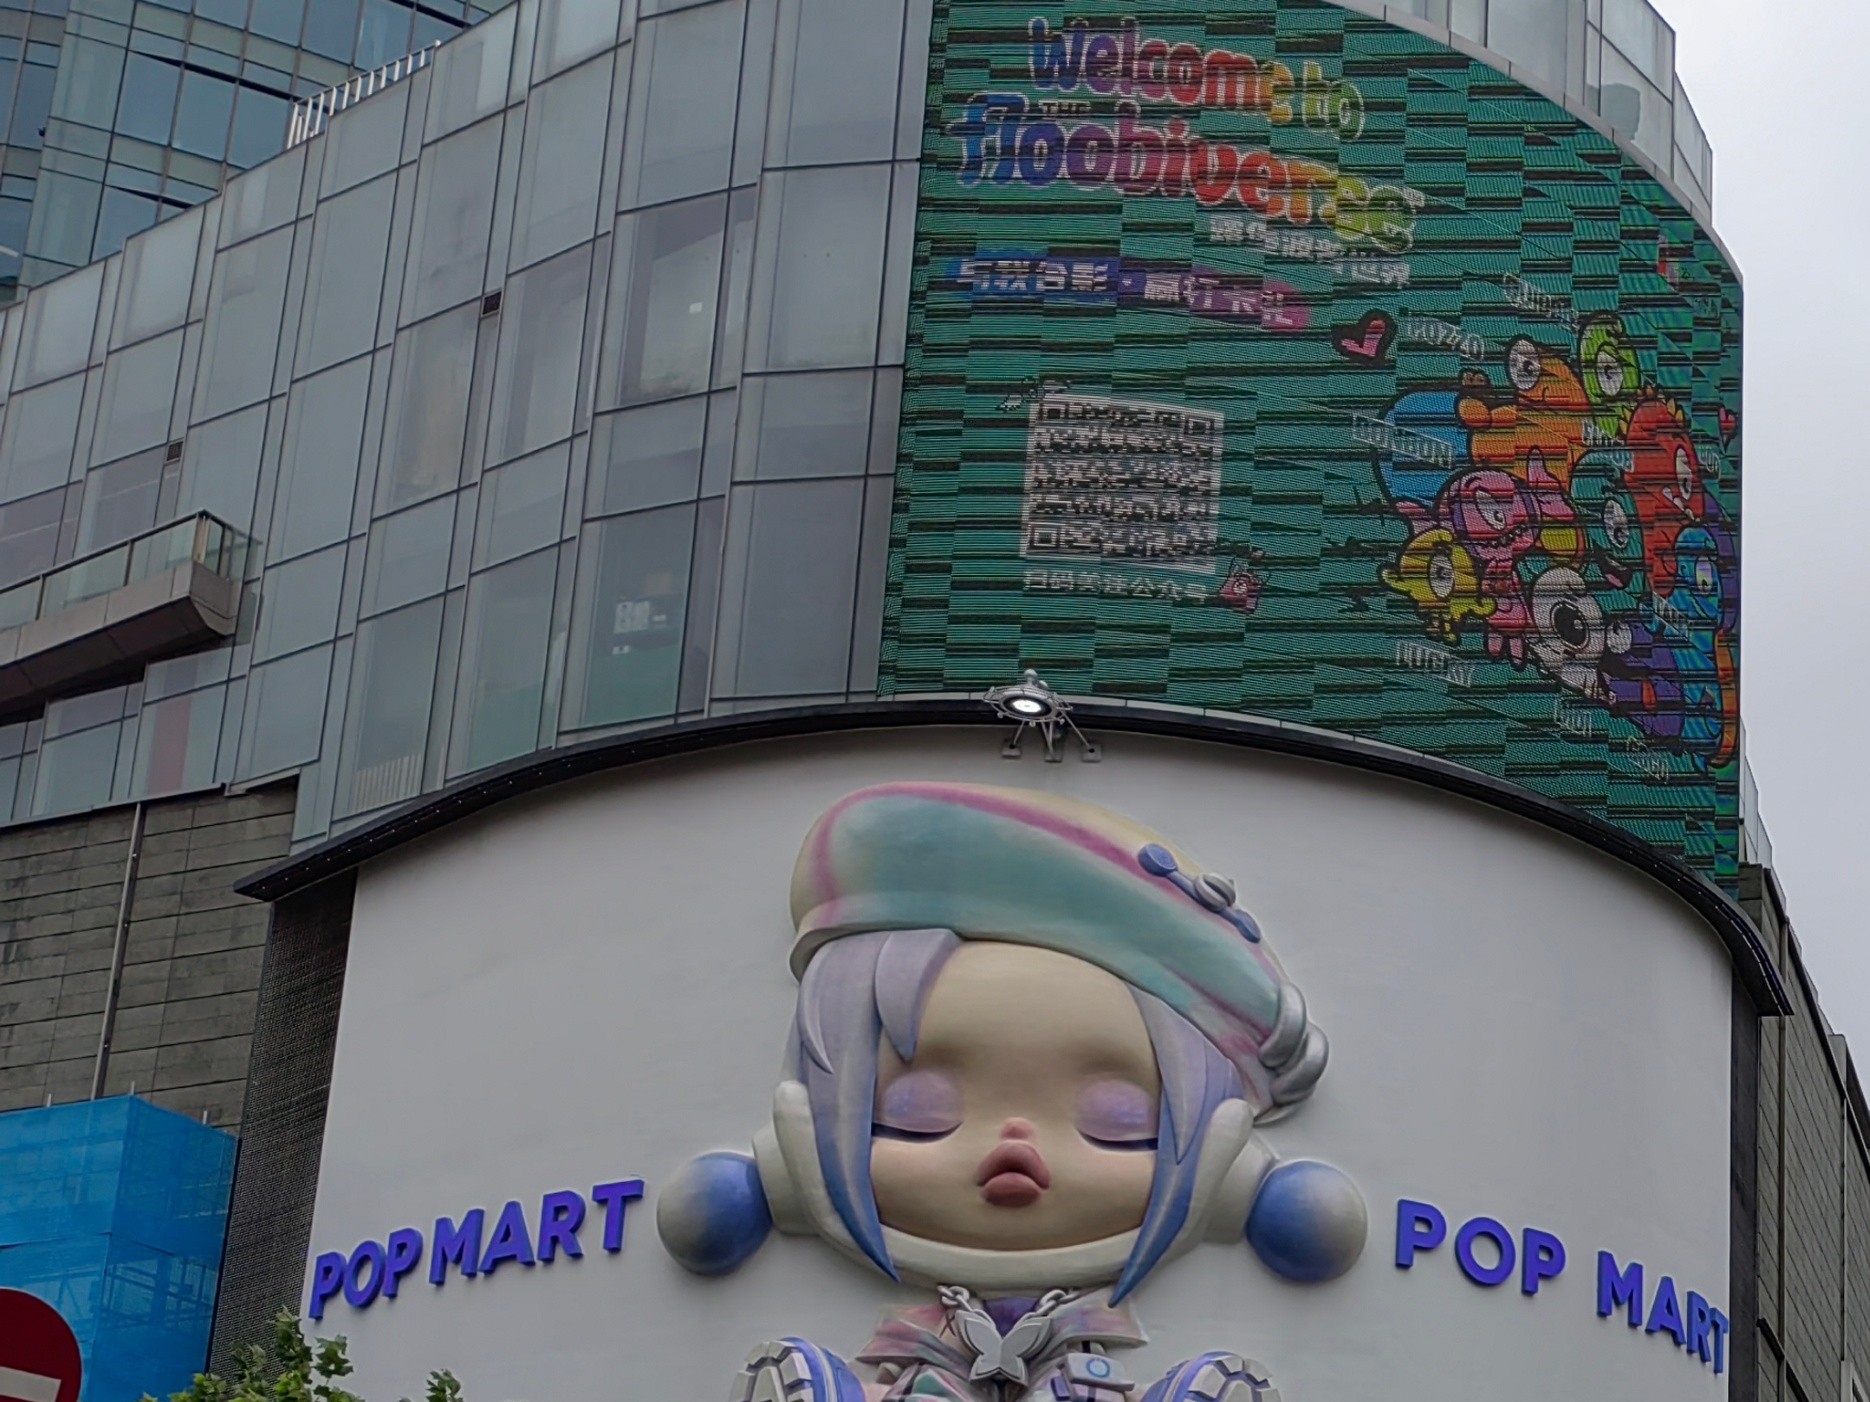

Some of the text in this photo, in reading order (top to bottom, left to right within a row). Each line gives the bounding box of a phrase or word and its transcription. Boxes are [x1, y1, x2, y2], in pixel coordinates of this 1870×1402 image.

[1302, 60, 1365, 142] to
[308, 1178, 646, 1321] POP MART
[1395, 1198, 1729, 1375] POP MART
